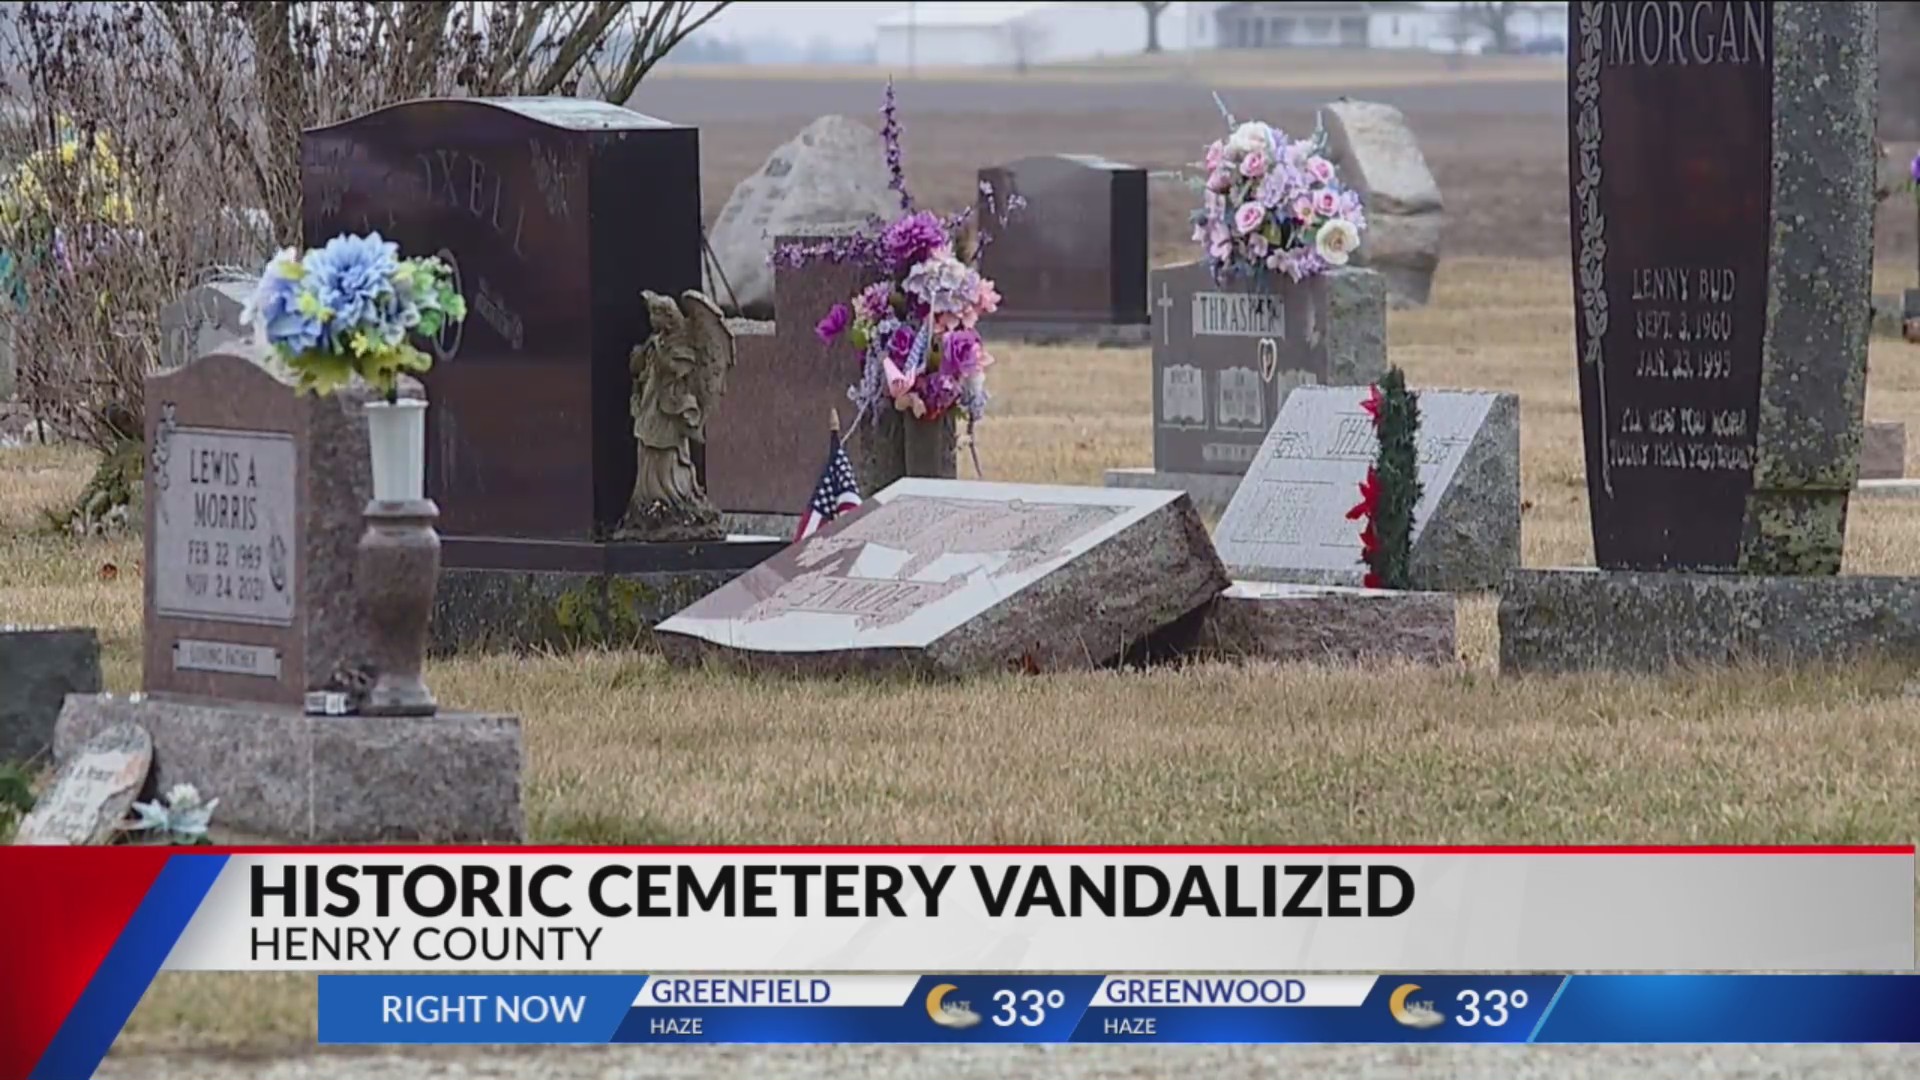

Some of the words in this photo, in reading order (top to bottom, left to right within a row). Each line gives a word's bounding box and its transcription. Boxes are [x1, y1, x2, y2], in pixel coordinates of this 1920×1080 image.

[1609, 1, 1766, 66] MORGAN
[1631, 268, 1689, 301] LENNY
[1699, 268, 1735, 302] BUD
[190, 449, 239, 486] LEWIS
[246, 455, 257, 488] A
[194, 493, 257, 531] MORRIS
[188, 540, 209, 565] FEB
[215, 541, 229, 567] 22
[215, 573, 232, 599] 24
